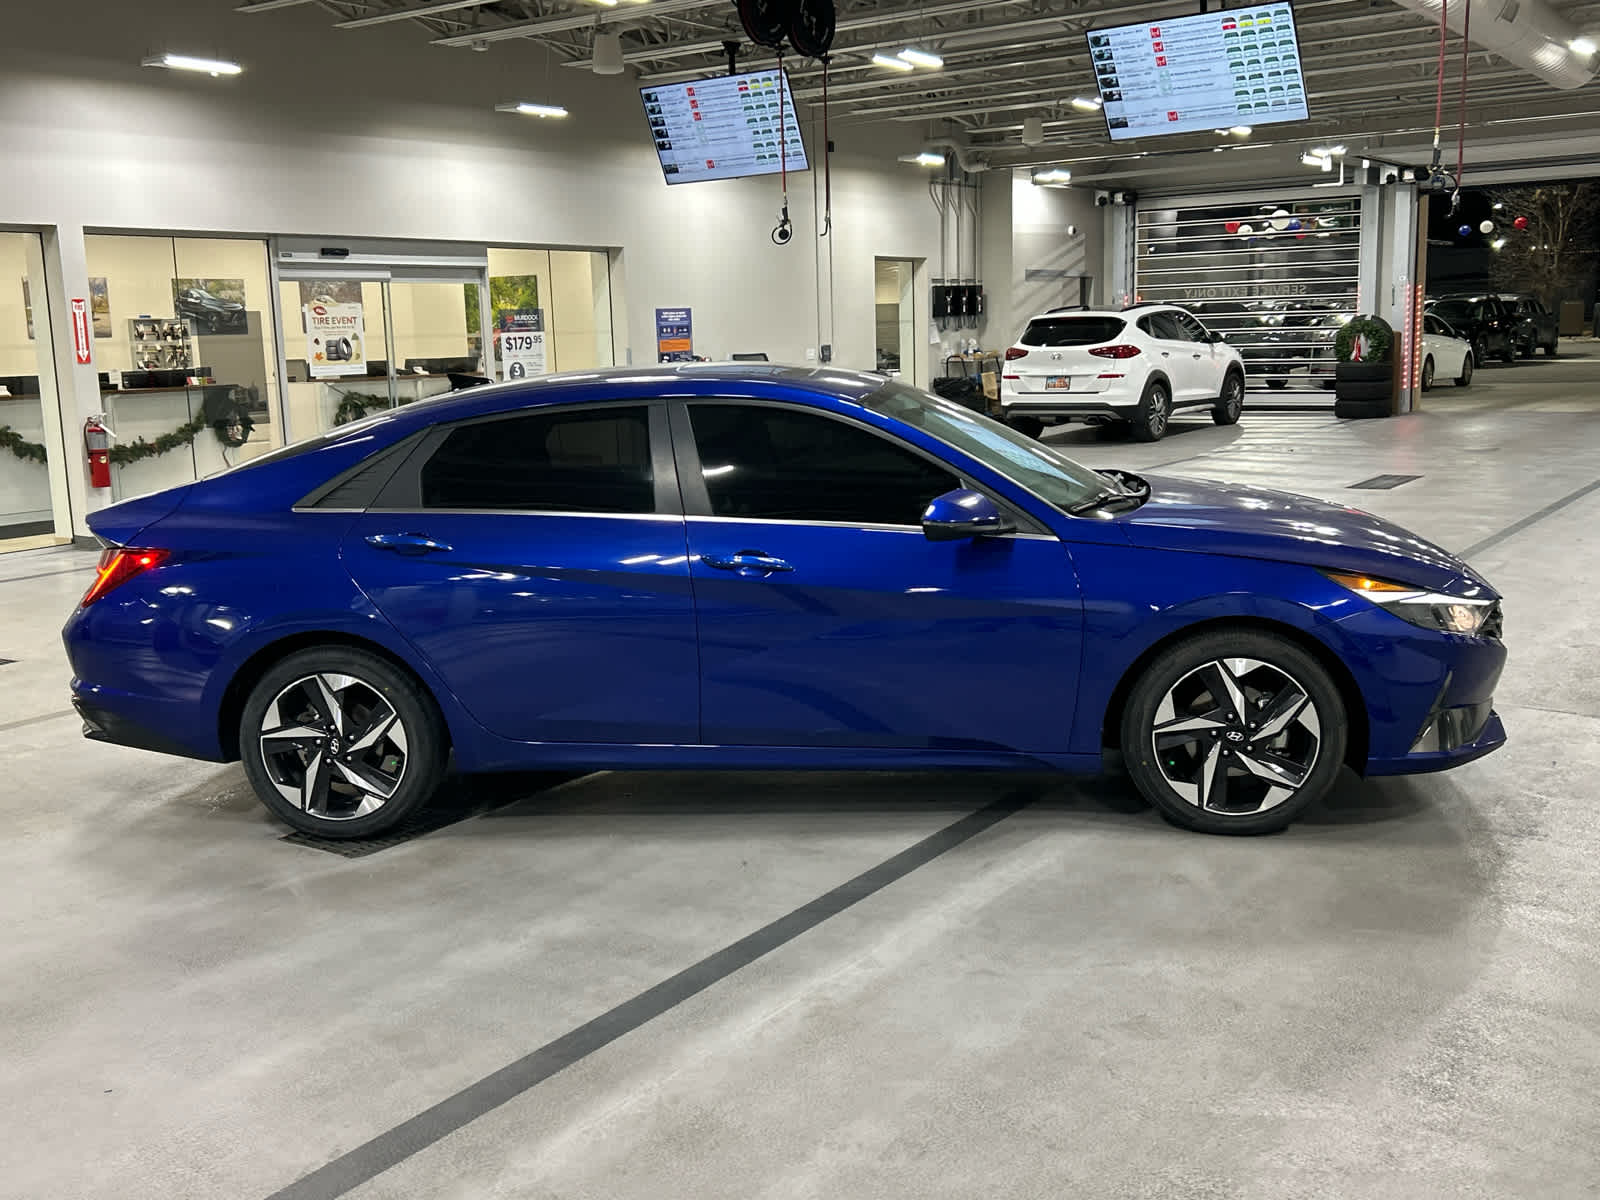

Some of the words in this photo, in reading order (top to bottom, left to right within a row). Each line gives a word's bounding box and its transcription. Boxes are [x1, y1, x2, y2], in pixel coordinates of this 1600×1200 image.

[312, 317, 330, 325] TIRE
[331, 316, 357, 325] EVENT
[513, 363, 520, 376] 3
